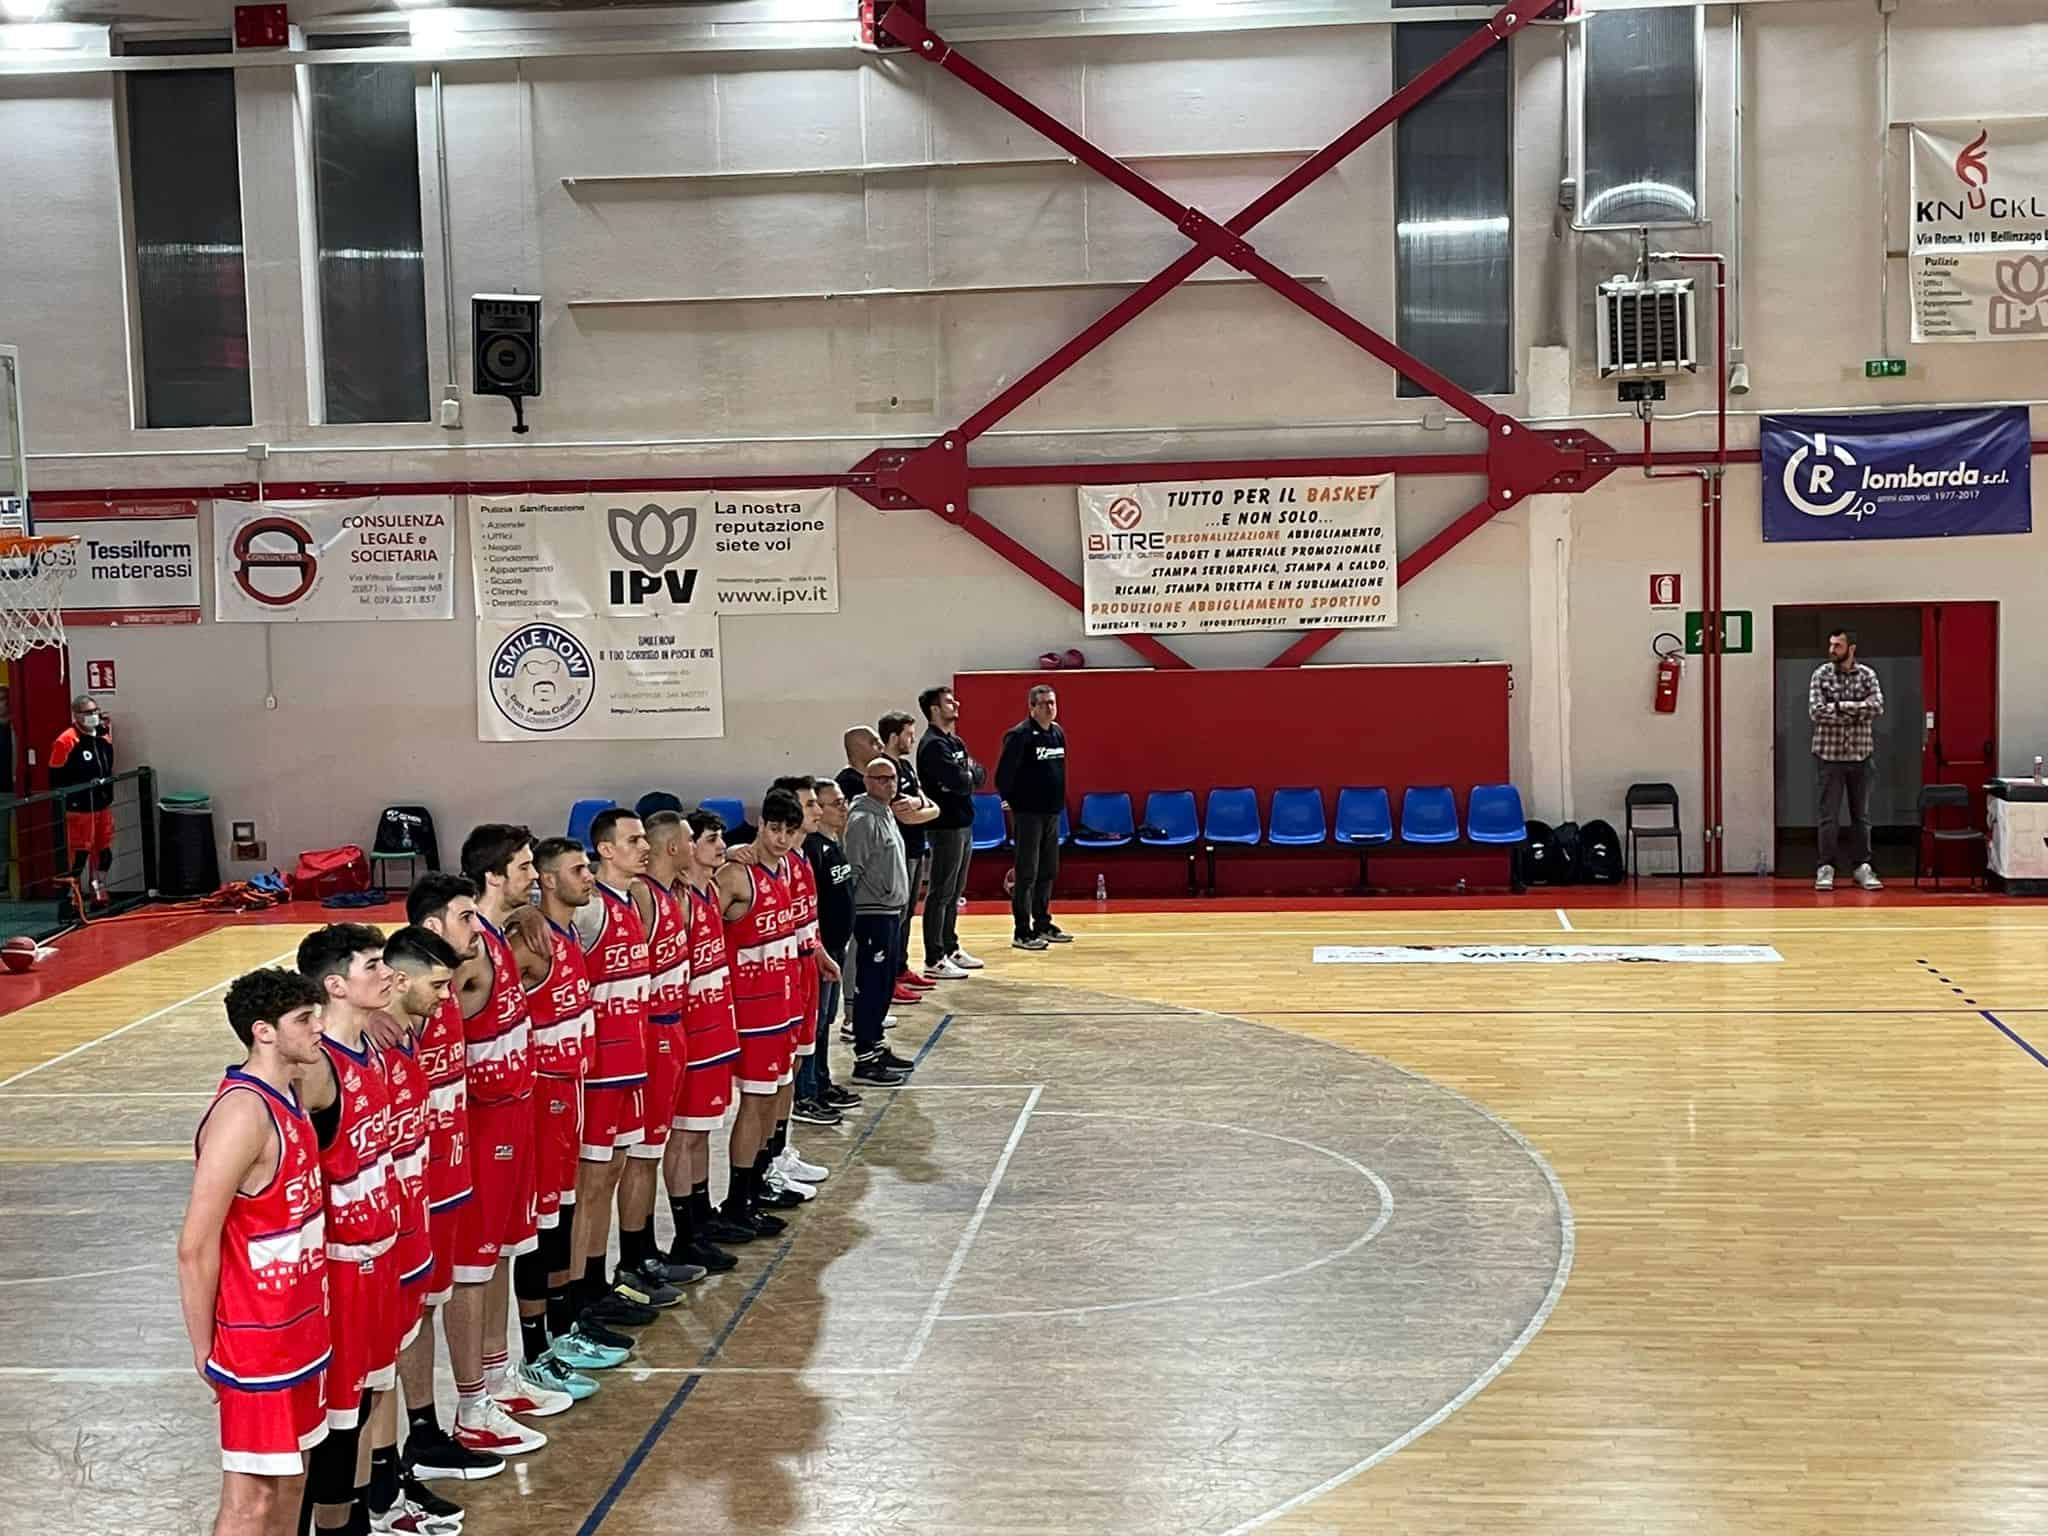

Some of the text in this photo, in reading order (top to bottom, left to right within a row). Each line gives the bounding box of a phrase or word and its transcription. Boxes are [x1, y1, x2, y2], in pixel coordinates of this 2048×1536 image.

[1917, 233, 1933, 245] Via
[1968, 232, 1985, 243] 101
[1991, 230, 2042, 244] Bellinzago
[1861, 461, 2009, 490] lombarda s.r.l.
[1168, 485, 1379, 507] TUTTO PER IL BASKET
[714, 501, 801, 514] La nostra
[342, 514, 445, 529] CONSULENZA
[715, 519, 824, 535] reputazione
[1238, 511, 1271, 525] NON
[360, 532, 427, 545] LEGALE e
[1088, 532, 1165, 551] BITRE
[1166, 526, 1384, 544] PERSONALIZZAZIONE ABBIGLIAMENTO,
[87, 540, 191, 560] Tessilform
[716, 538, 791, 552] siete voi
[1166, 544, 1382, 560] GADGET E MATERIALE PROMOZIONALE
[351, 549, 439, 563] SOCIETARIA
[92, 560, 192, 579] materassi
[1151, 567, 1197, 577] STAMPA
[1202, 563, 1279, 575] SERIGRAFICA,
[1284, 562, 1331, 573] STAMPA
[1336, 562, 1343, 571] A
[610, 569, 698, 605] IPV
[717, 586, 828, 605] www.ipv.it
[1114, 577, 1384, 596] RICAMI, STAMPA DIRETTA E IN SUBLIMAZIONE
[1091, 594, 1381, 615] PRODUZIONE ABBIGLIAMENTO SPORTIVO
[499, 631, 587, 675] SMILE NOW
[449, 1131, 463, 1168] 16
